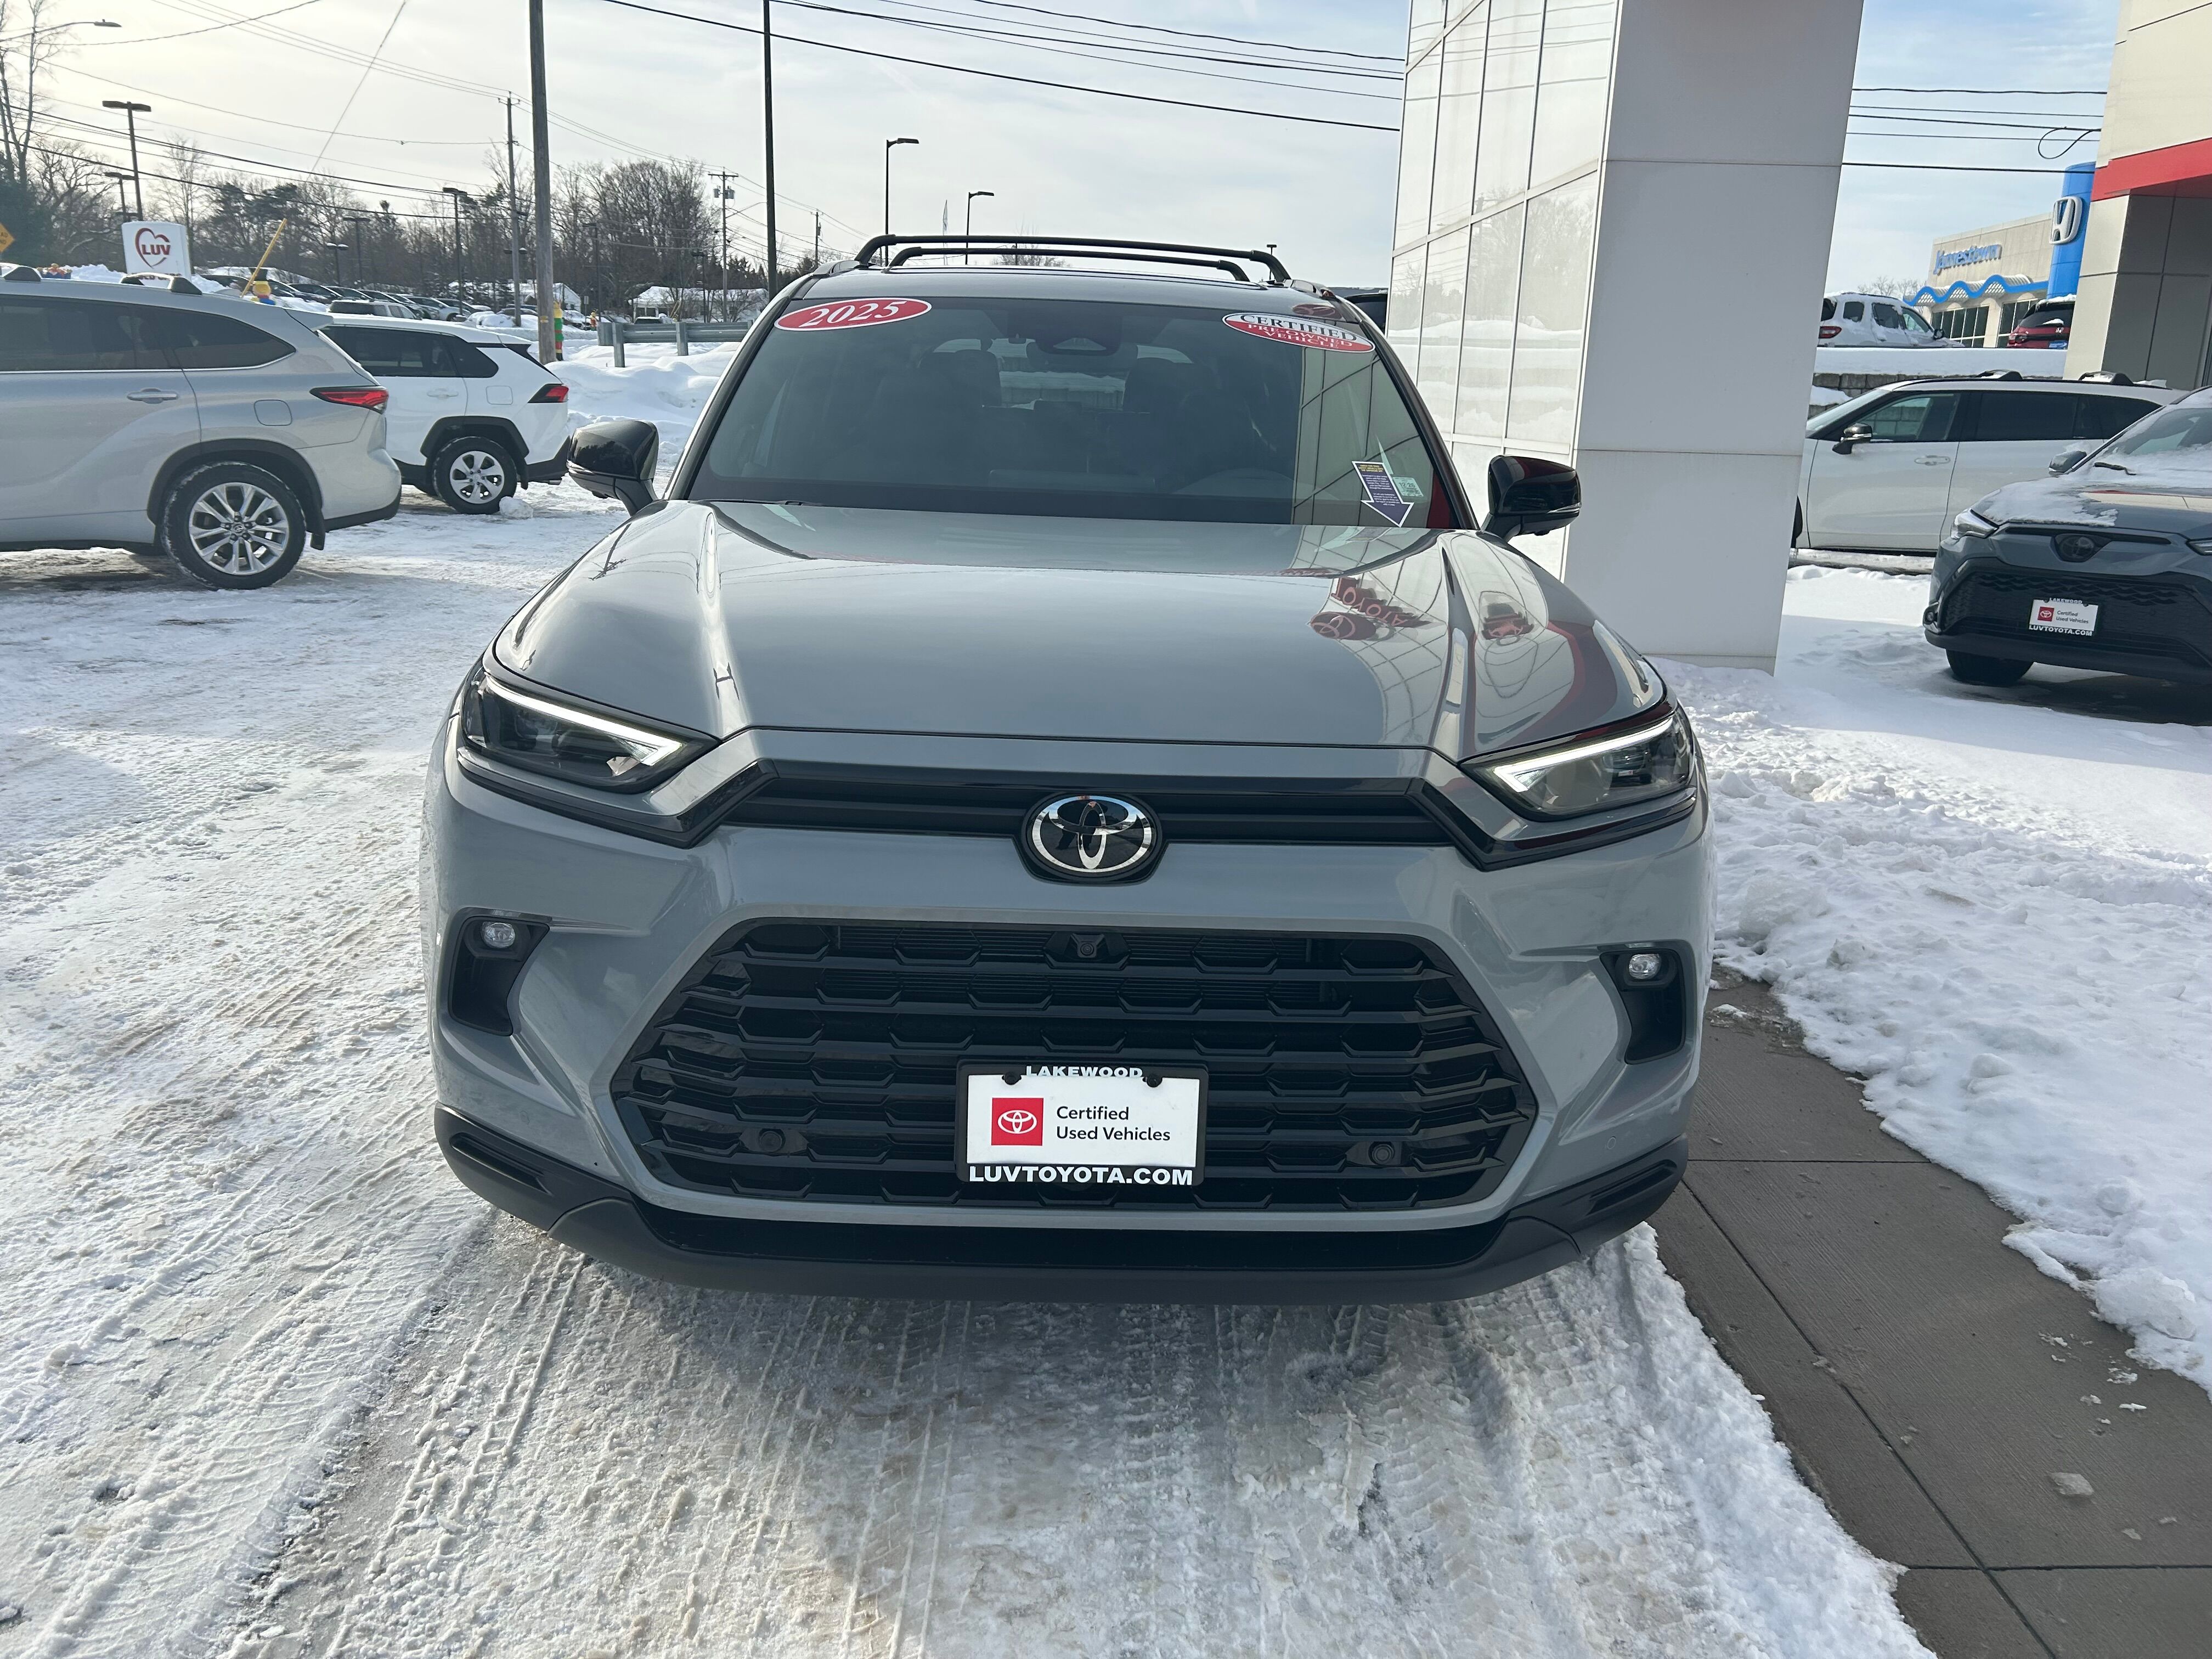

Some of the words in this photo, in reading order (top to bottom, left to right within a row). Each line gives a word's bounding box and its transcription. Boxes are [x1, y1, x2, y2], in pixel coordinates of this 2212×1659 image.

[142, 244, 171, 255] LUV
[1933, 244, 2001, 275] Jamestown
[798, 301, 907, 328] 2025
[1240, 315, 1357, 341] CERTIFIED
[1248, 324, 1352, 346] PRE-OWNED
[1263, 331, 1339, 348] VEHICLE
[2029, 625, 2092, 636] LUVTOYOTA.COM
[1026, 1065, 1143, 1077] LAKEWOOD
[1057, 1106, 1129, 1120] Certified
[1057, 1126, 1097, 1140] Used
[1103, 1127, 1171, 1141] Vehicles
[969, 1166, 1193, 1186] LUVTOYOTA.COM
